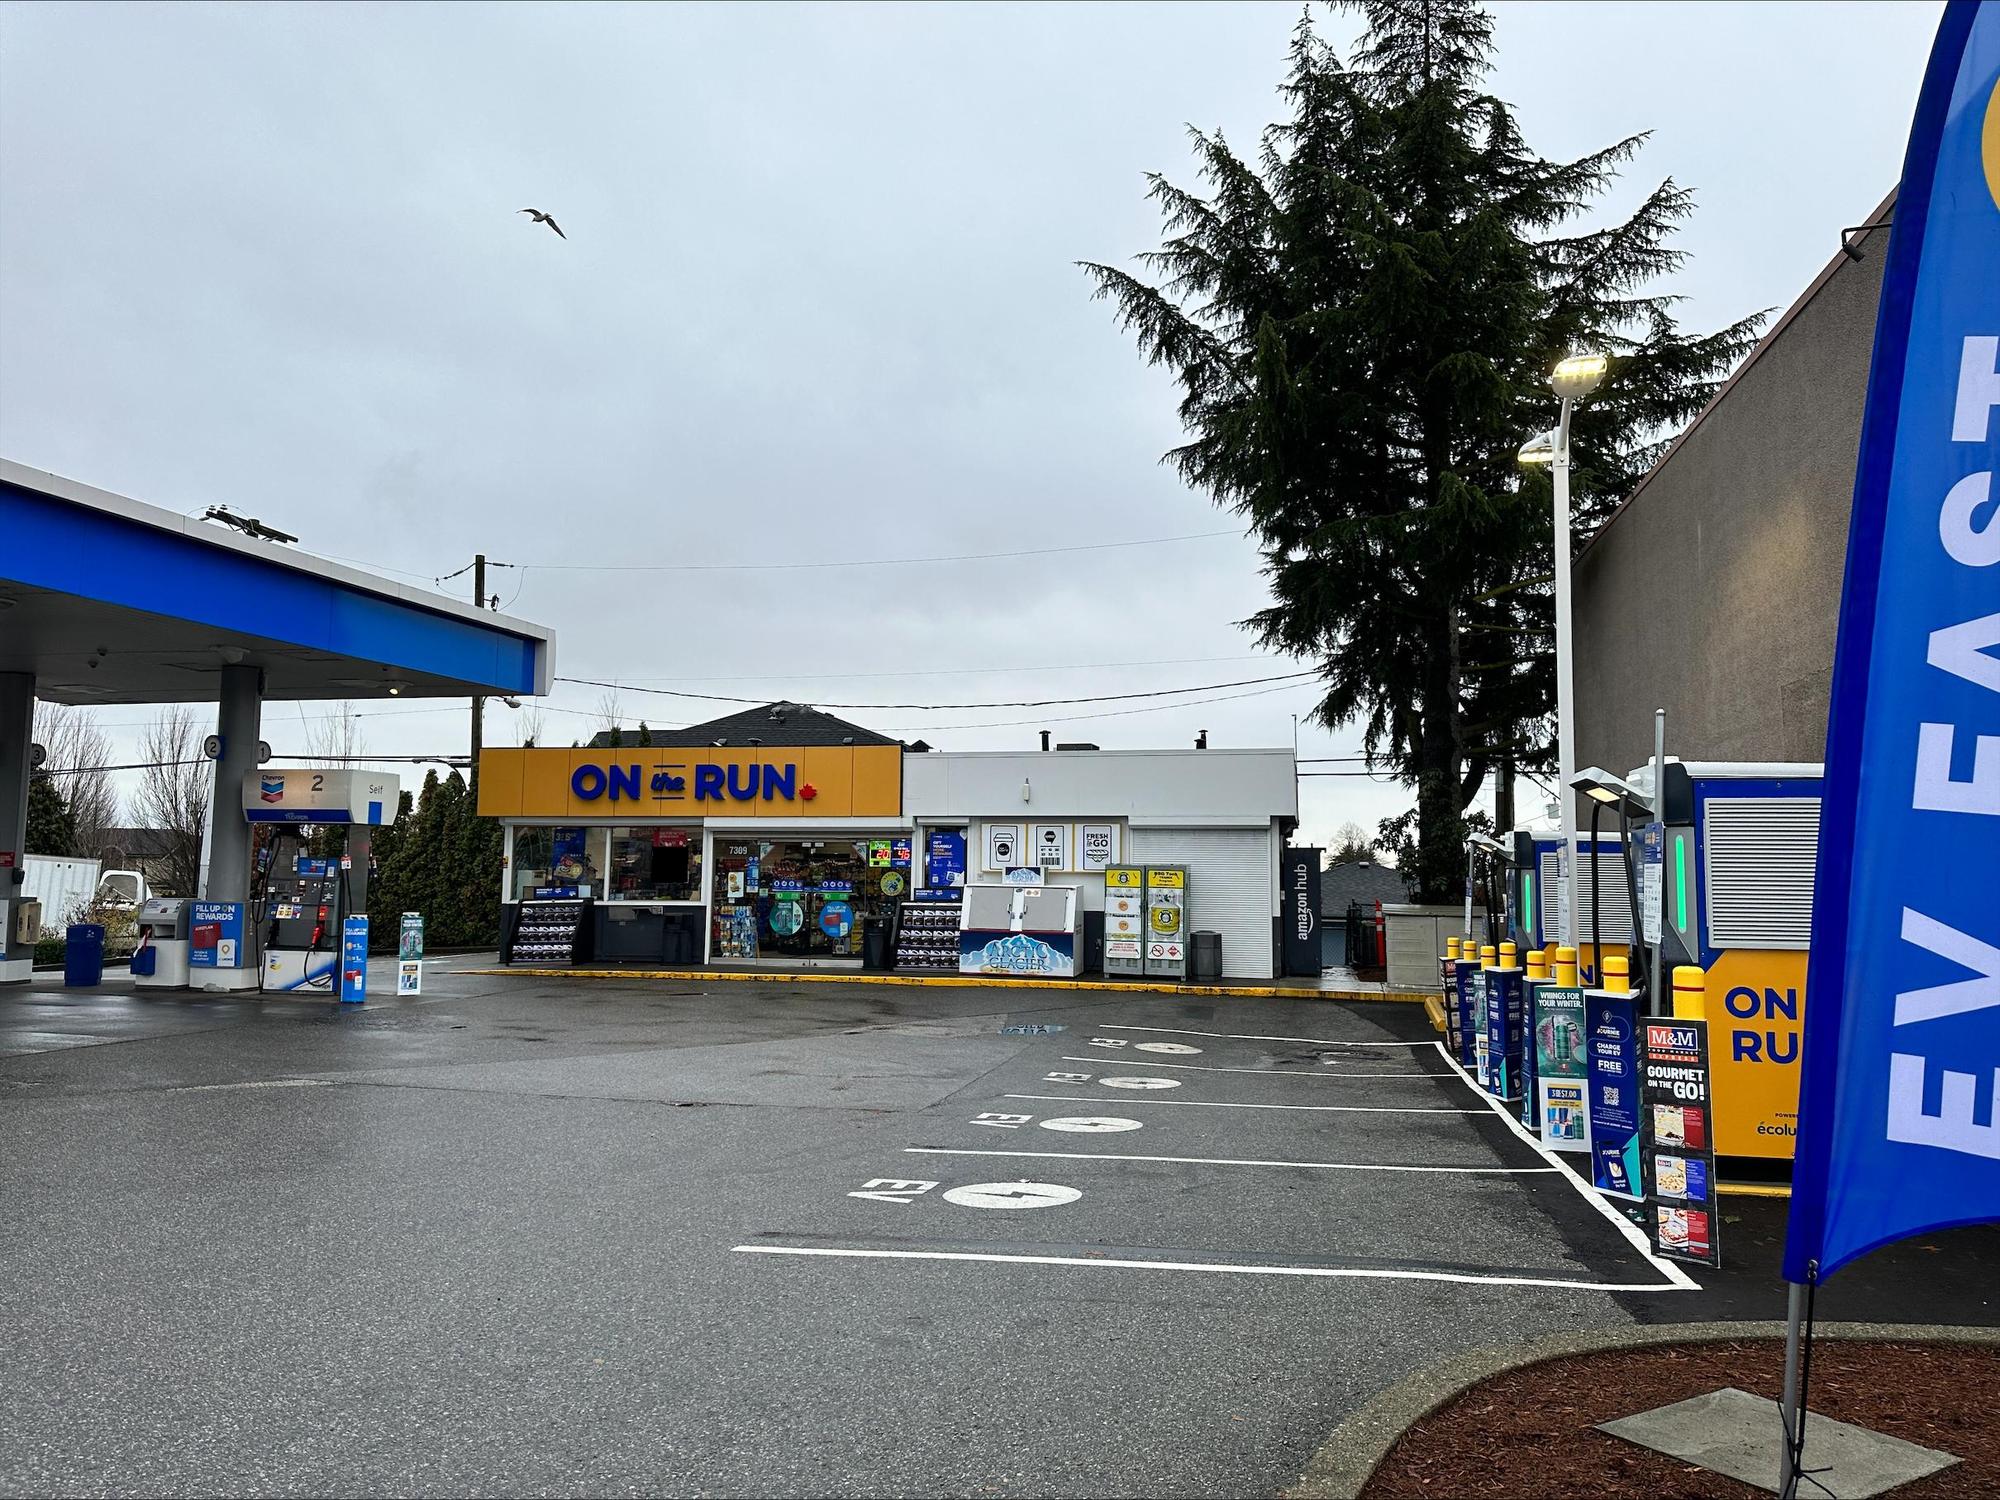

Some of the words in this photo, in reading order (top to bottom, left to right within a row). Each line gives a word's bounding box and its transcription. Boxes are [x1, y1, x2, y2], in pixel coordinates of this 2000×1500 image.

[34, 749, 41, 760] 3
[210, 742, 217, 753] 2
[260, 747, 266, 758] 1
[311, 775, 324, 792] 2
[369, 784, 384, 795] Self
[571, 763, 642, 801] ON
[650, 772, 685, 792] the
[694, 763, 797, 801] RUN
[729, 846, 748, 855] 7309
[1093, 839, 1108, 847] GO
[1293, 863, 1307, 890] hub
[195, 904, 209, 912] FILL
[209, 904, 220, 912] UP
[222, 904, 235, 912] ON
[195, 912, 234, 920] REWARDS
[1298, 892, 1308, 941] amazon
[988, 941, 1049, 959] ARCTIC
[989, 957, 1048, 970] GLACIER
[1538, 999, 1556, 1007] YOUR
[1557, 1000, 1583, 1008] WINTER.
[1725, 986, 1798, 1020] ON
[1651, 1029, 1694, 1047] M&M
[1596, 1042, 1621, 1050] CHARGE
[1732, 1030, 1799, 1064] RU
[1597, 1060, 1622, 1071] FREE
[1647, 1065, 1705, 1082] GOURMET
[1647, 1079, 1658, 1087] ON
[1659, 1080, 1673, 1089] THE
[1673, 1081, 1705, 1101] GO!
[968, 1112, 1034, 1129] EV
[1757, 1121, 1797, 1136] écolu
[846, 1178, 941, 1204] EV
